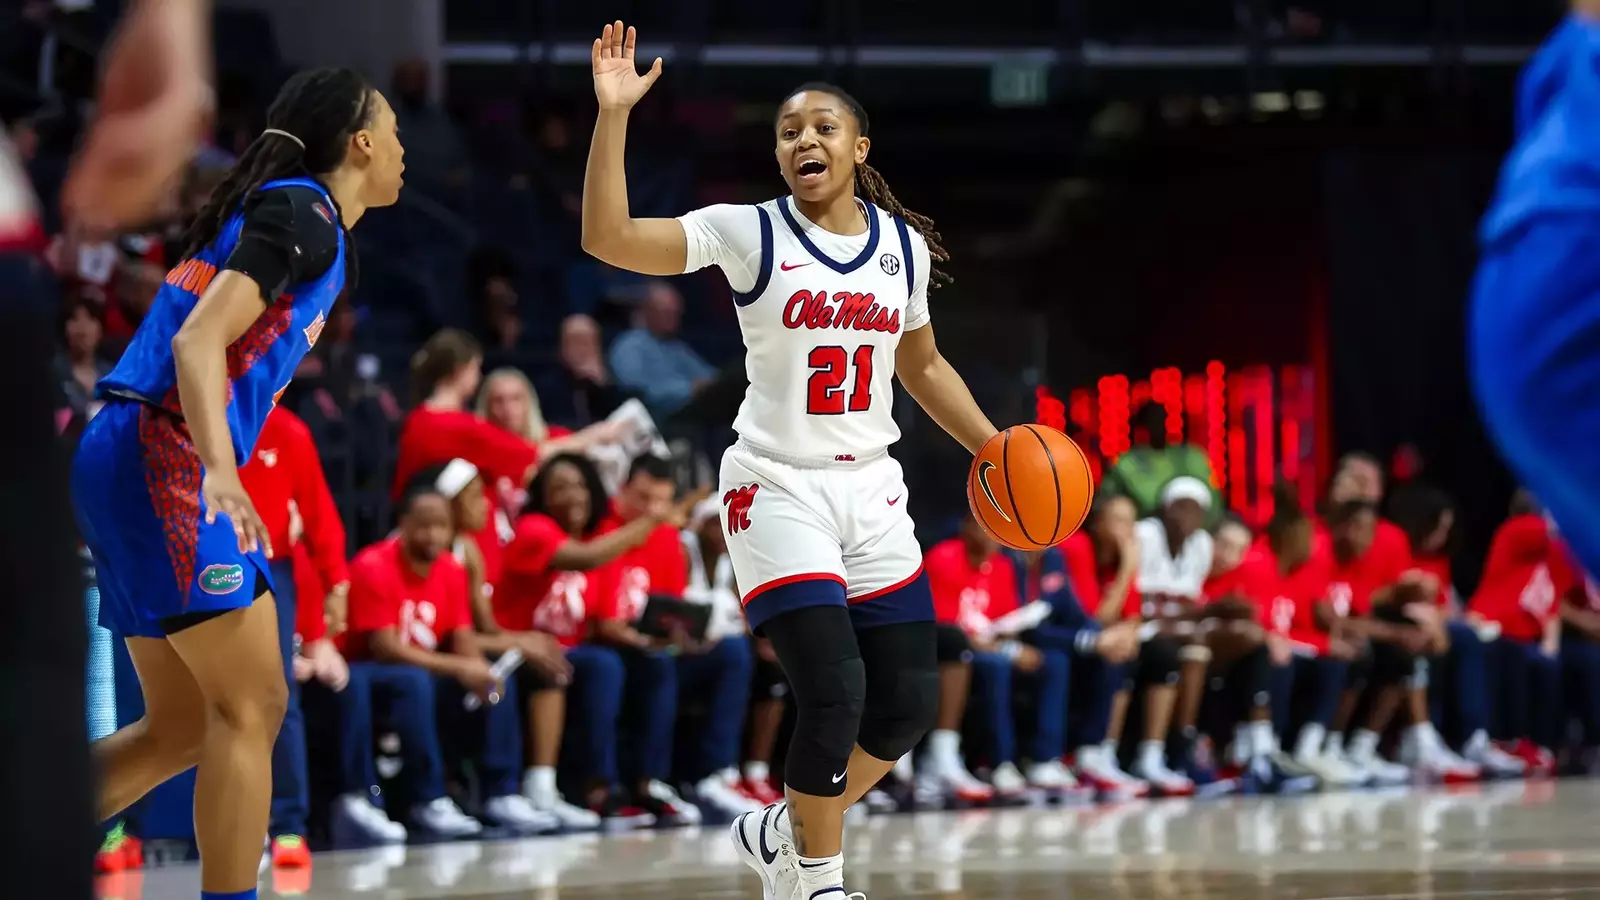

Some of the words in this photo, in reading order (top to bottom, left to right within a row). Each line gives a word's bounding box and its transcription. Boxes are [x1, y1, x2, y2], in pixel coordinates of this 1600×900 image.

[881, 257, 899, 273] SEC
[782, 289, 834, 330] Ole
[832, 291, 900, 334] Miss
[806, 344, 875, 415] 21
